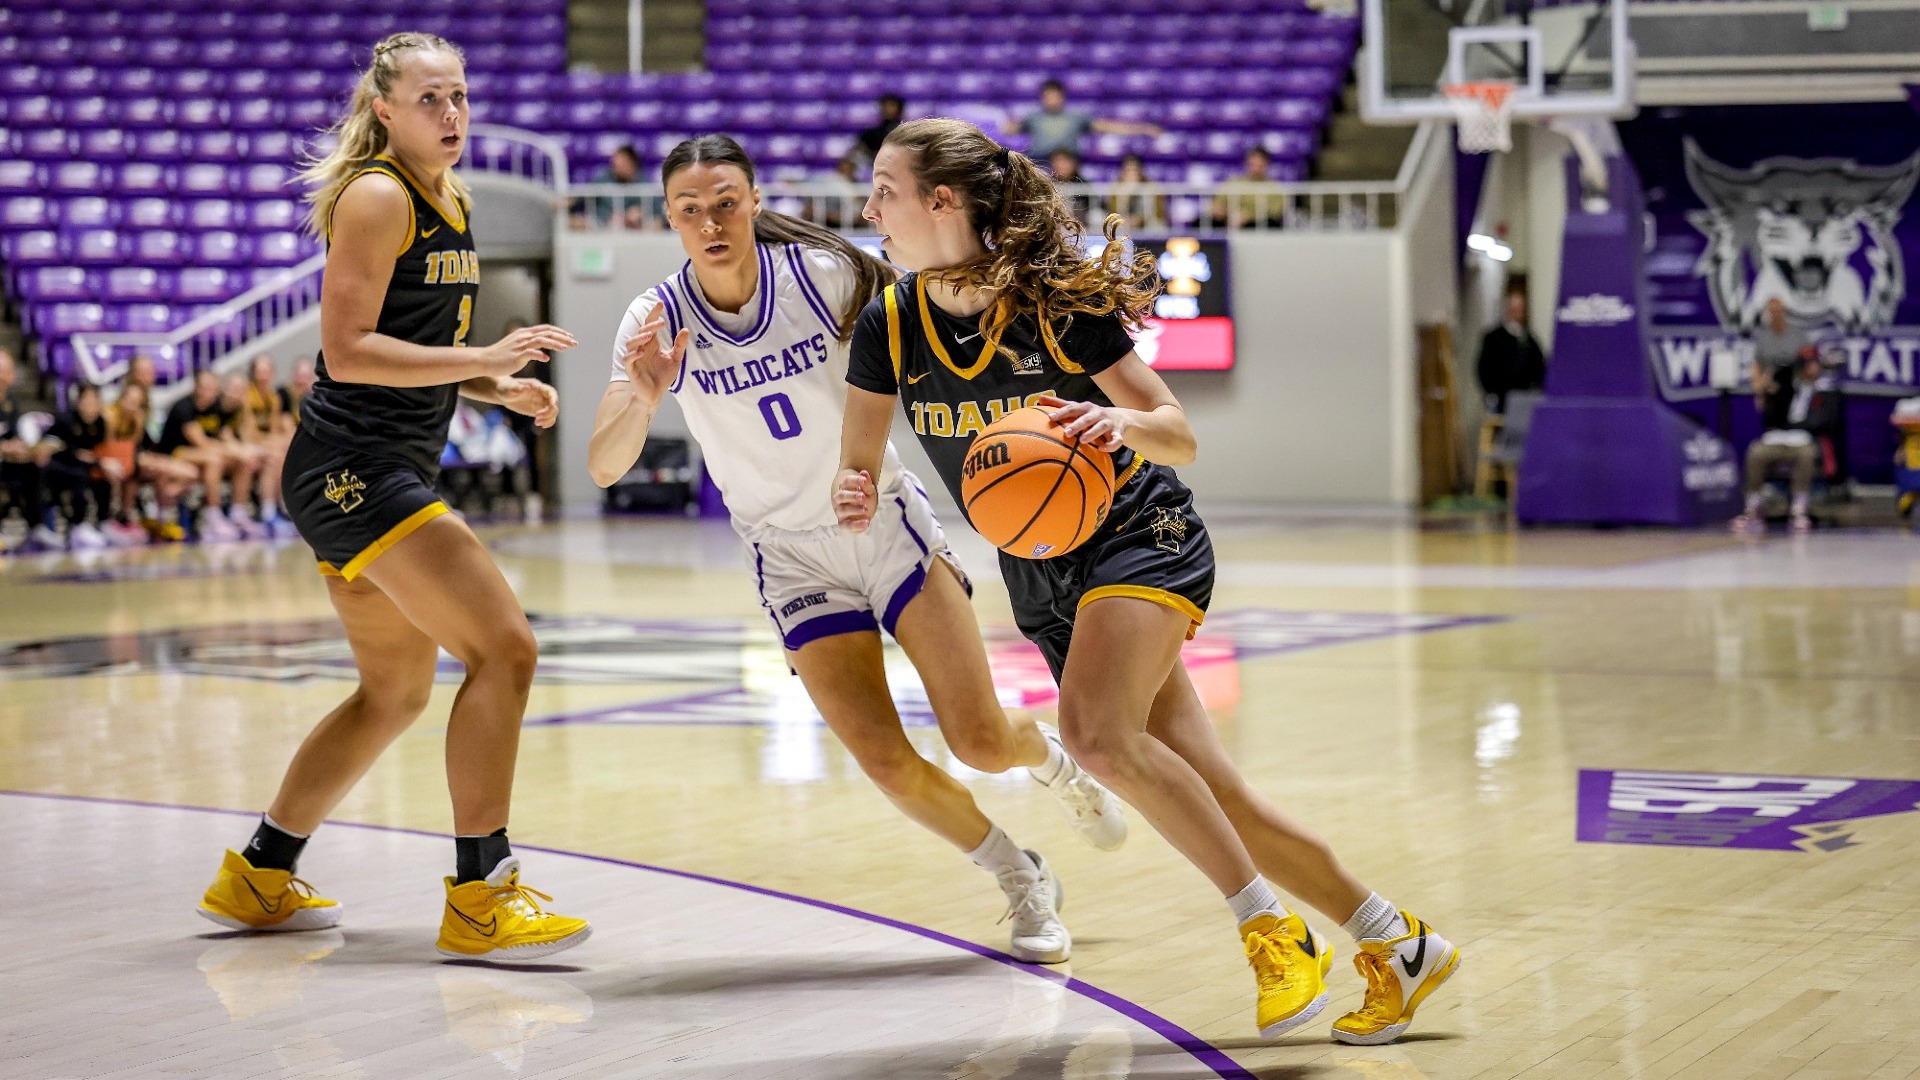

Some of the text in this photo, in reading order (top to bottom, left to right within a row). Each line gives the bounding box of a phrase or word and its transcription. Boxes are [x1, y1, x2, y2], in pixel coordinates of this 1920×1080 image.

[424, 249, 480, 285] IDAH
[453, 294, 473, 347] 2
[691, 333, 828, 395] WILDCATS
[1023, 354, 1040, 369] SKY
[1818, 339, 1920, 383] TAT
[758, 392, 803, 440] 0
[962, 442, 1012, 484] Wils
[803, 591, 828, 607] STATE
